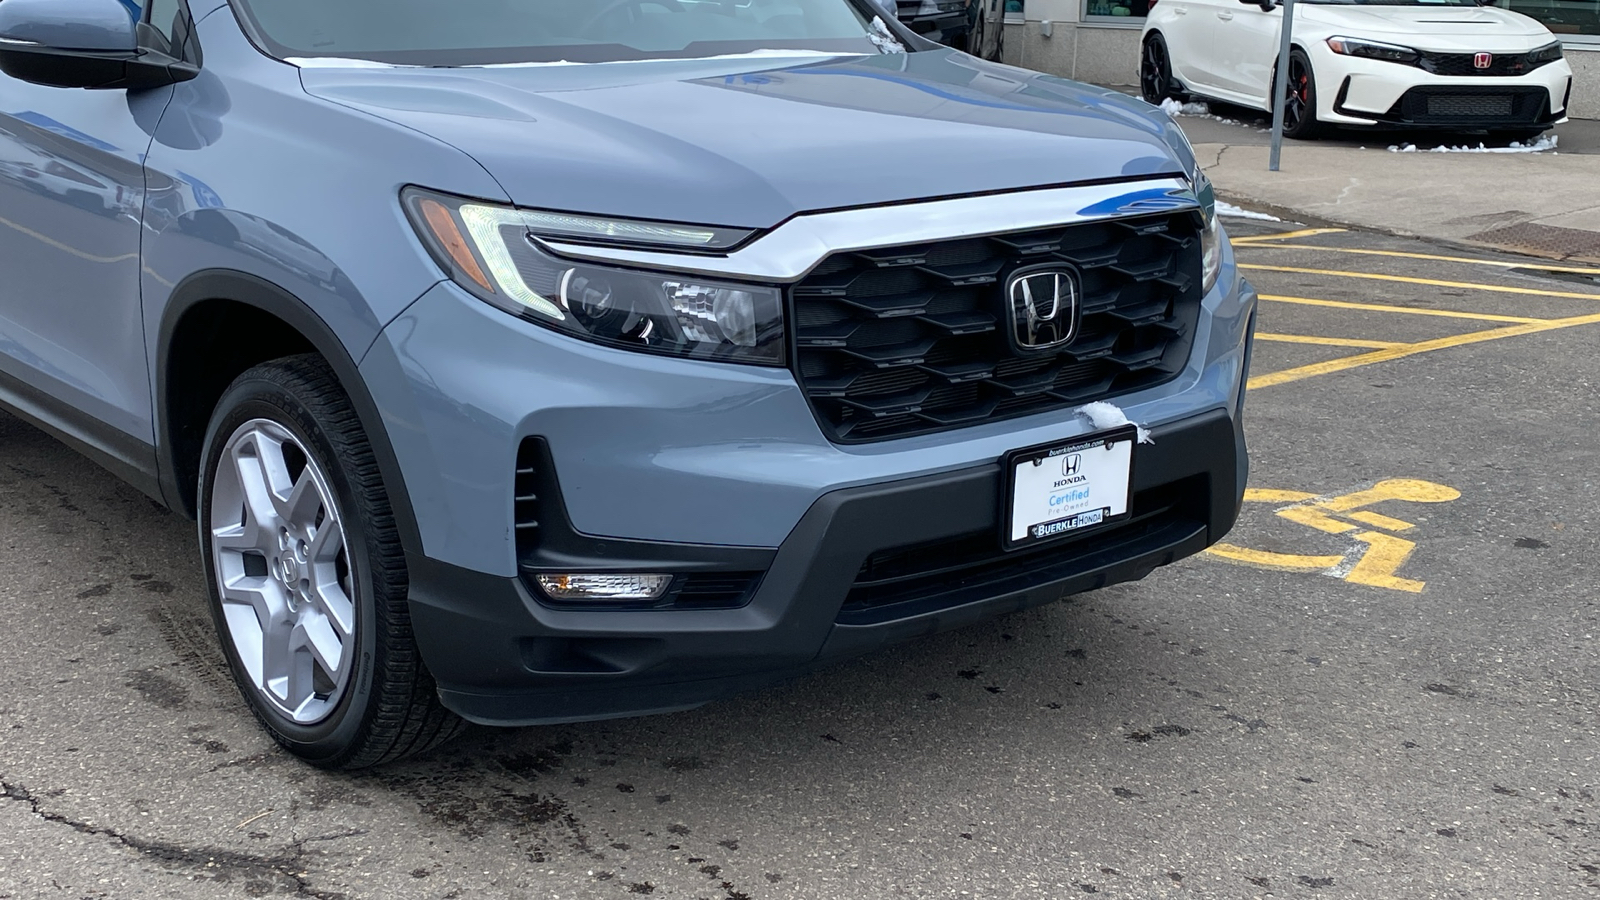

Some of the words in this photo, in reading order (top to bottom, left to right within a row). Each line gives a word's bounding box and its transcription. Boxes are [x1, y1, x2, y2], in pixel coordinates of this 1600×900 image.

[1048, 440, 1105, 456] buerklehonda.com
[1054, 475, 1086, 487] HONDA
[1049, 487, 1090, 507] Certified
[1048, 500, 1089, 516] Pre-Owned
